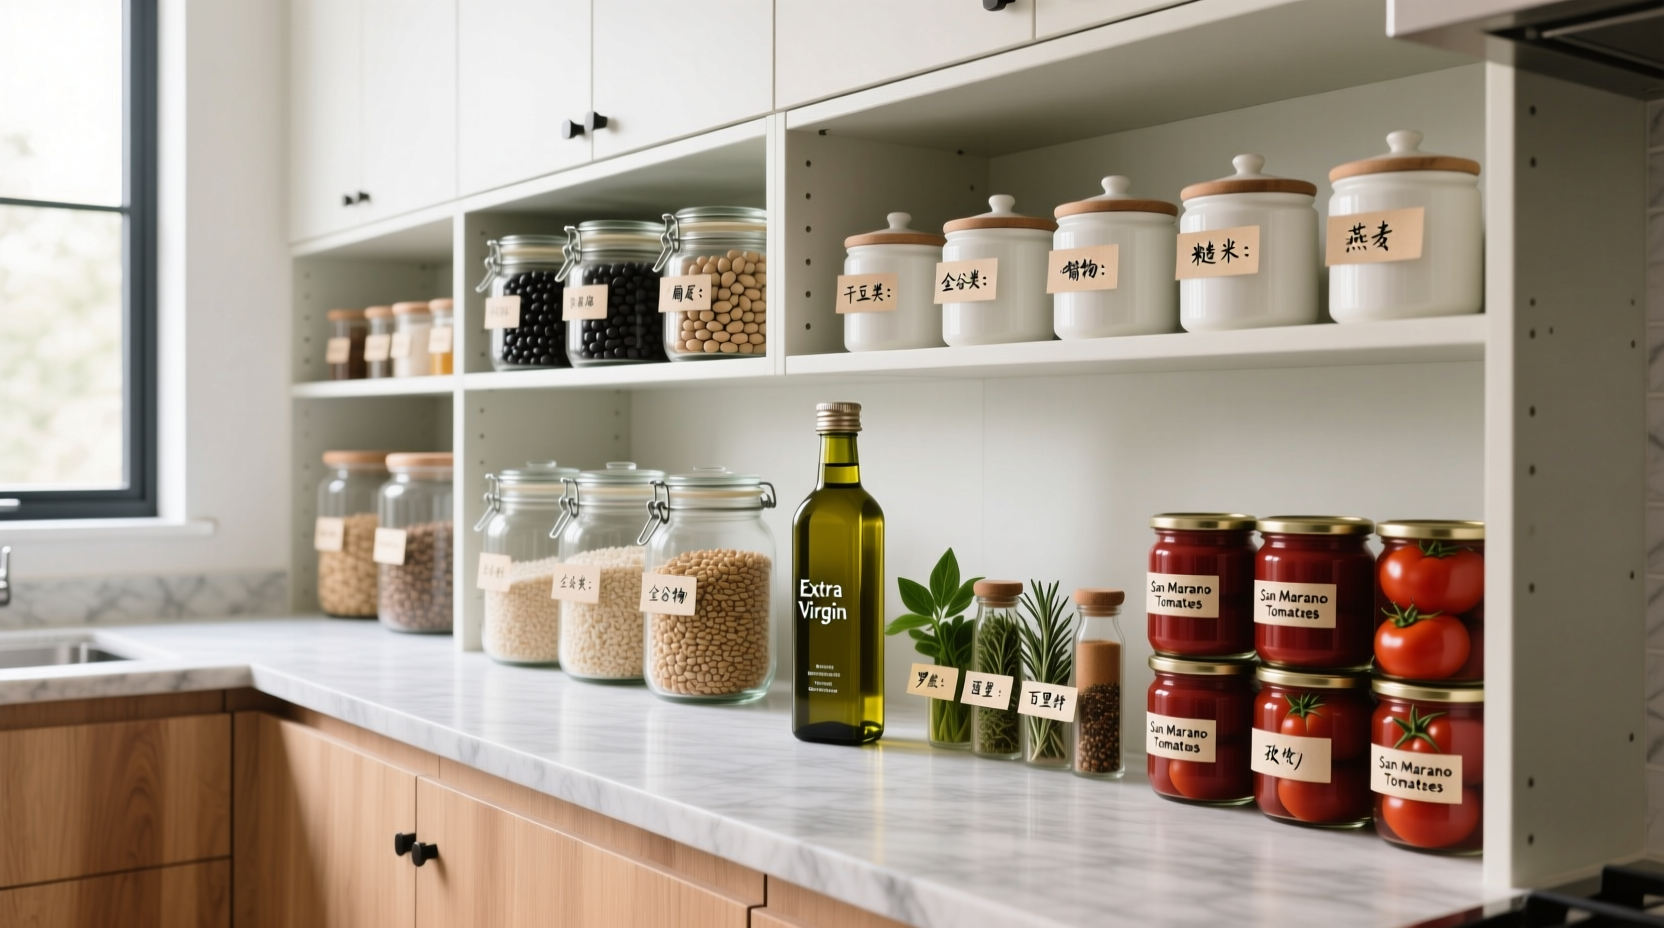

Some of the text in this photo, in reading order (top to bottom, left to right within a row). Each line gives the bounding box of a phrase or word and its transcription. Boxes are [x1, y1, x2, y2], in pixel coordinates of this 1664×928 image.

[800, 579, 843, 598] Extra
[1150, 580, 1212, 595] San Marano
[1279, 590, 1329, 604] Marano
[798, 600, 847, 625] Virgin
[1150, 720, 1208, 739] San Marano
[1379, 755, 1453, 777] San Marano
